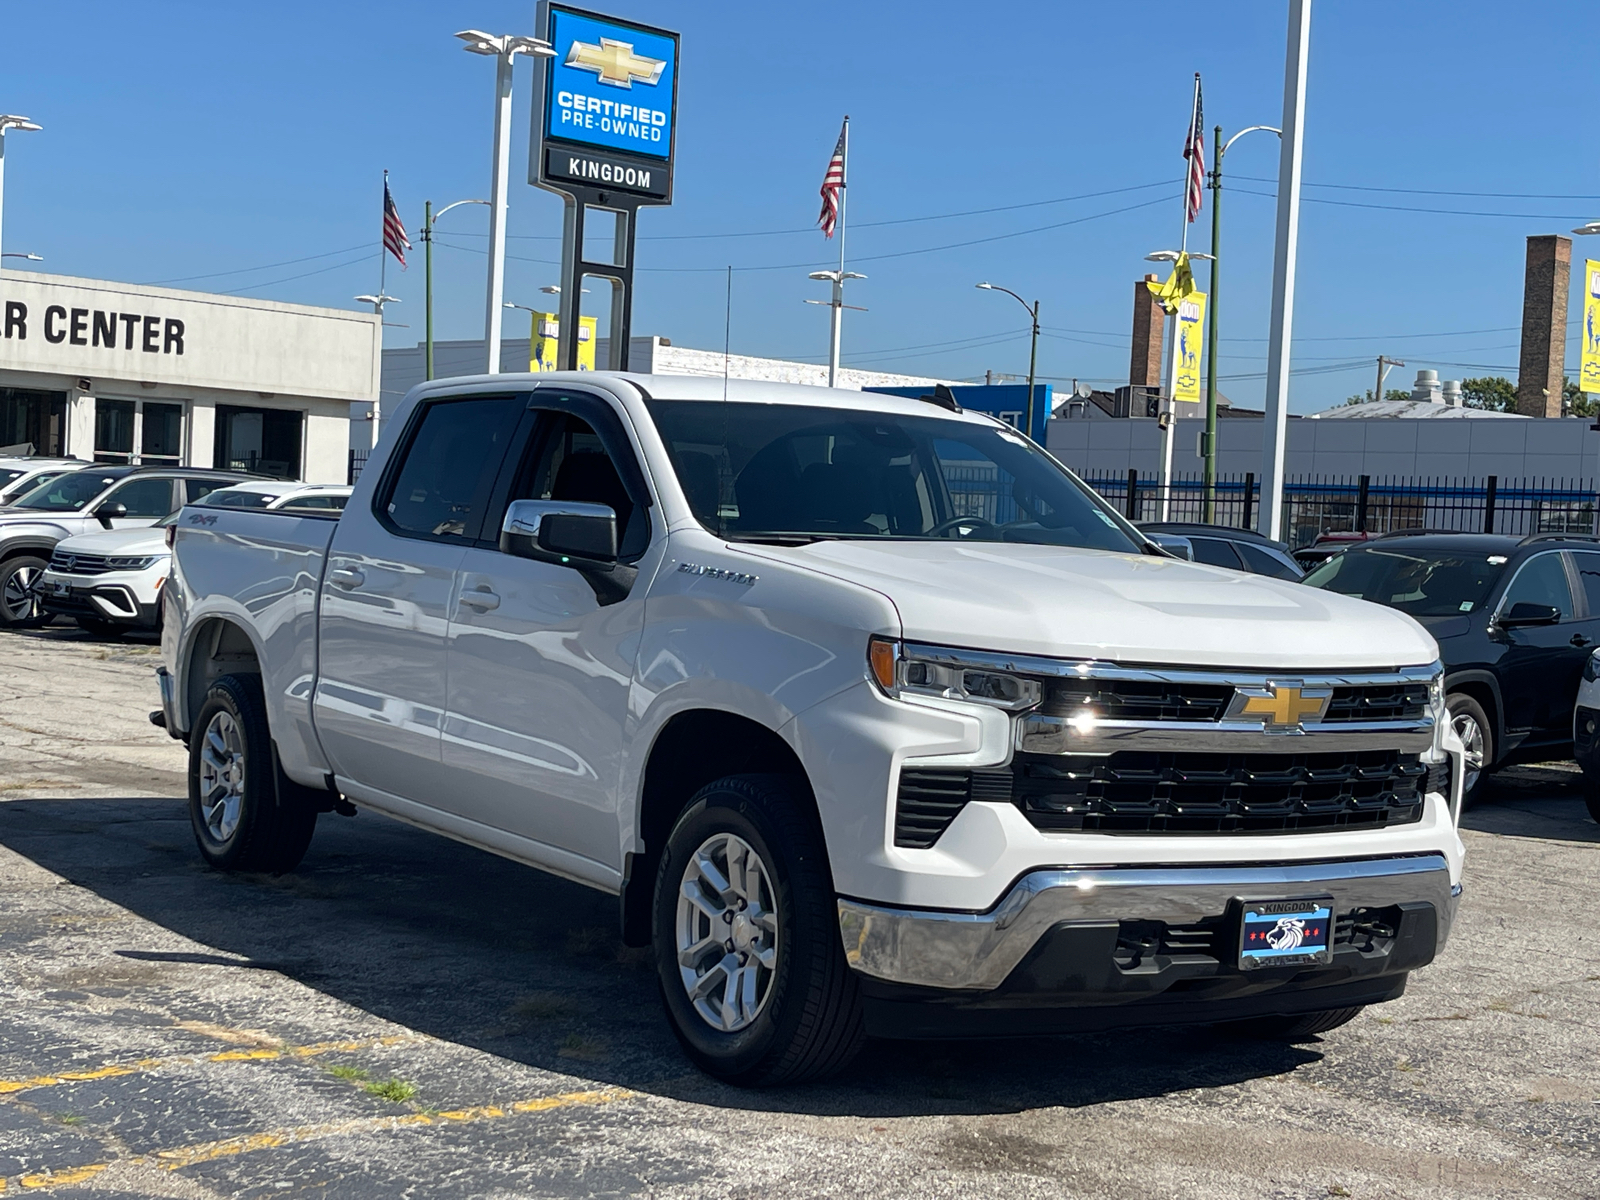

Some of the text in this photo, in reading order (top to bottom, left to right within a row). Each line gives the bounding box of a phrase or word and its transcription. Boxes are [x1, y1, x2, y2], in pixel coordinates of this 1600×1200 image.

[557, 90, 666, 127] CERTIFIED
[561, 109, 661, 142] PRE-OWNED
[569, 157, 650, 188] KINGDOM
[0, 300, 185, 355] R CENTER
[1265, 902, 1315, 913] KINGDOM
